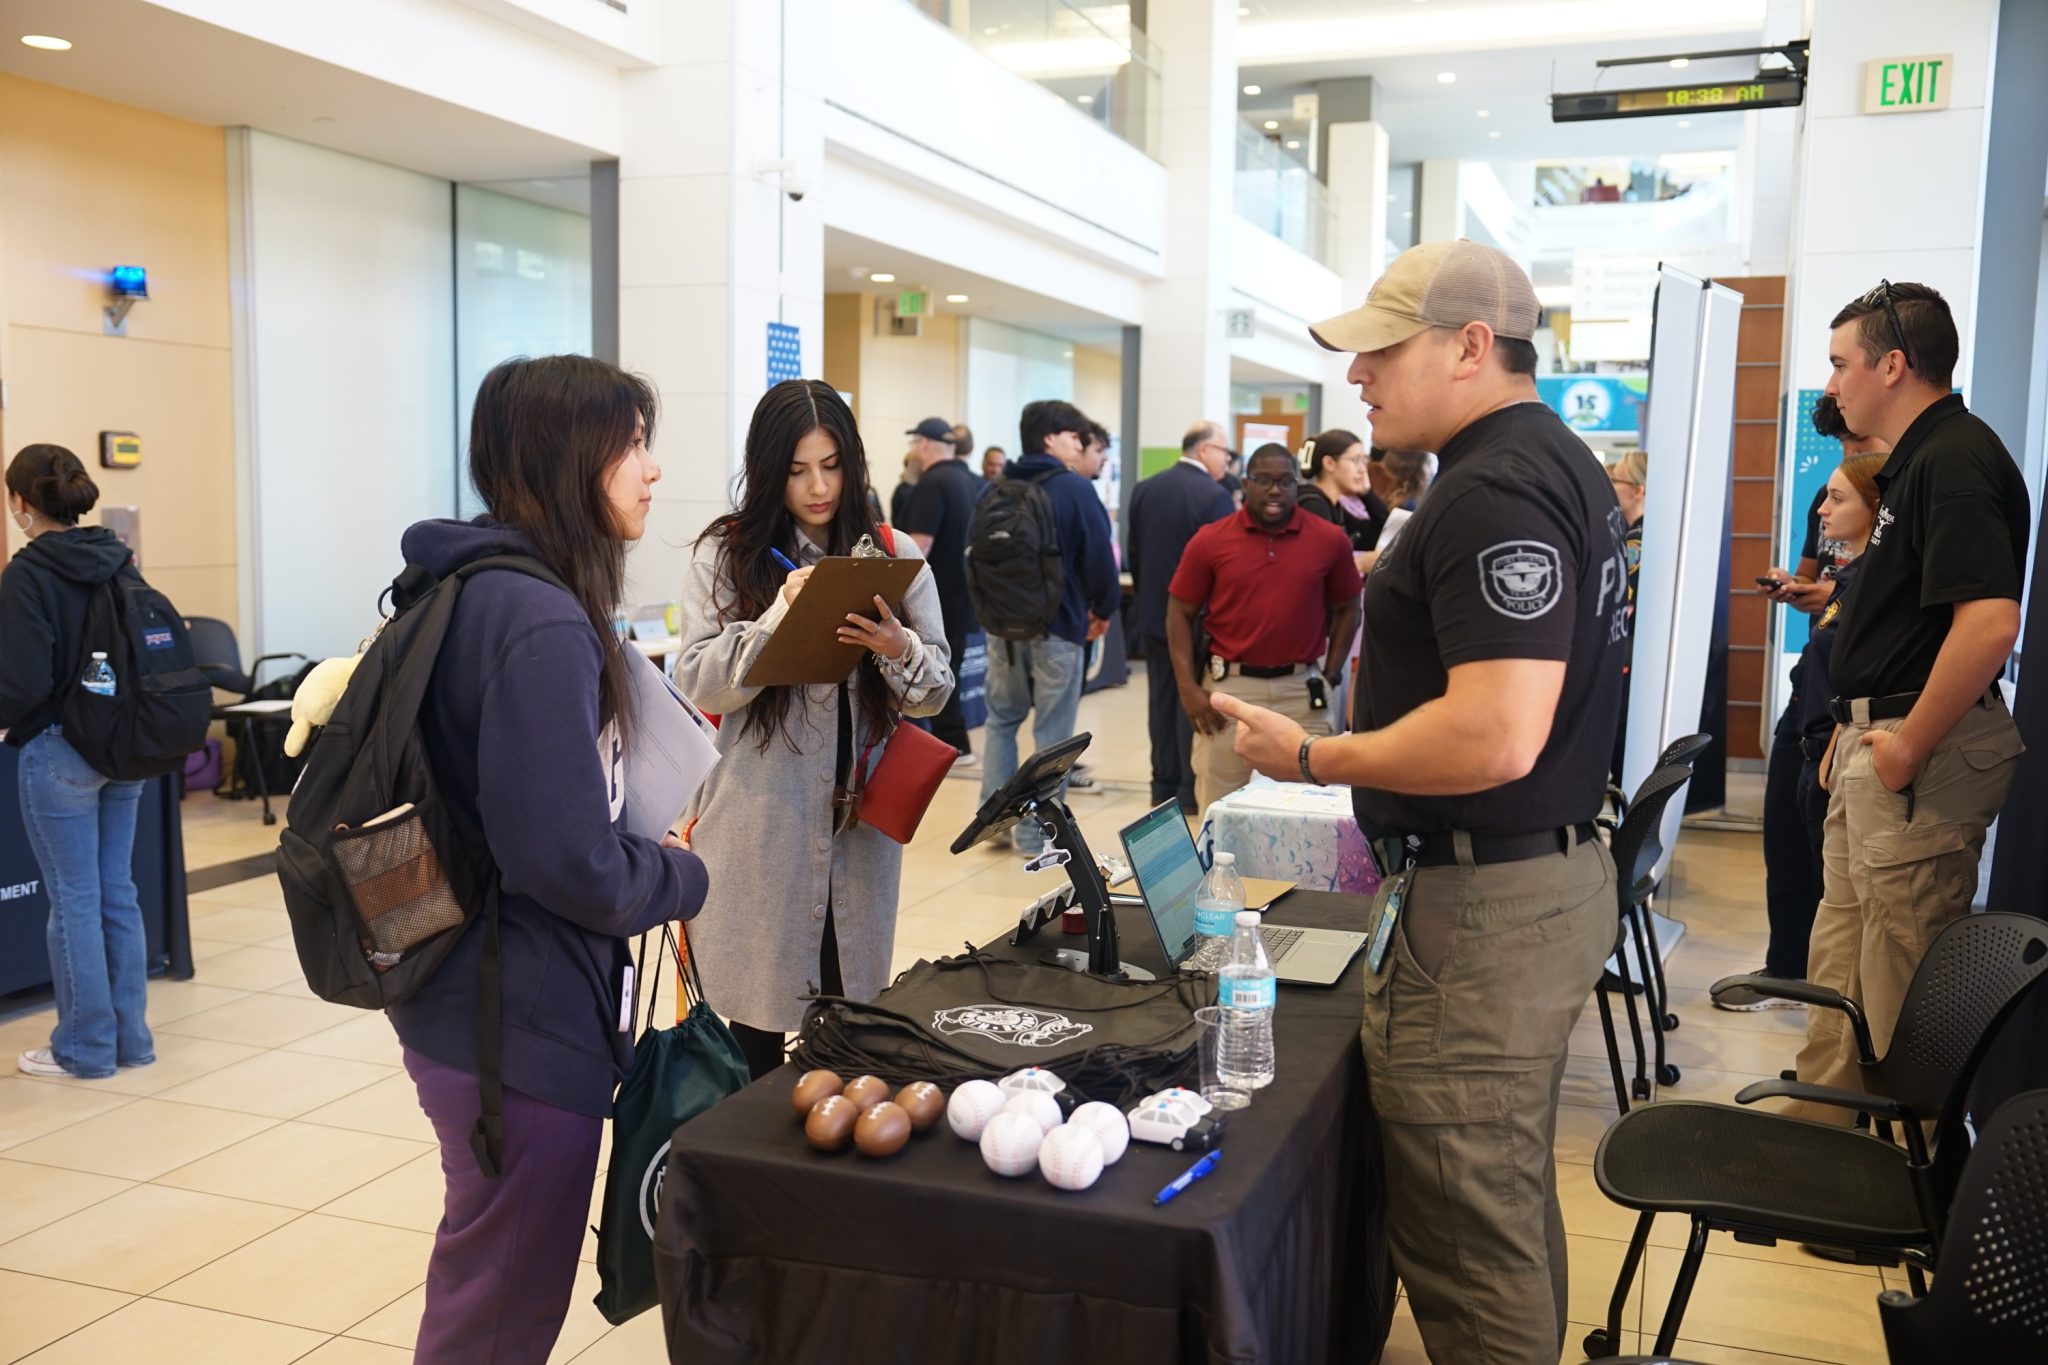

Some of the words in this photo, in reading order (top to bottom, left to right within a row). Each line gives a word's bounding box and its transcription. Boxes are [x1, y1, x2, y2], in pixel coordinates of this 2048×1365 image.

[1880, 60, 1943, 106] EXIT
[1665, 86, 1724, 106] 10:38
[1735, 83, 1764, 102] AM
[1505, 598, 1545, 612] POLICE
[0, 880, 40, 902] MENT
